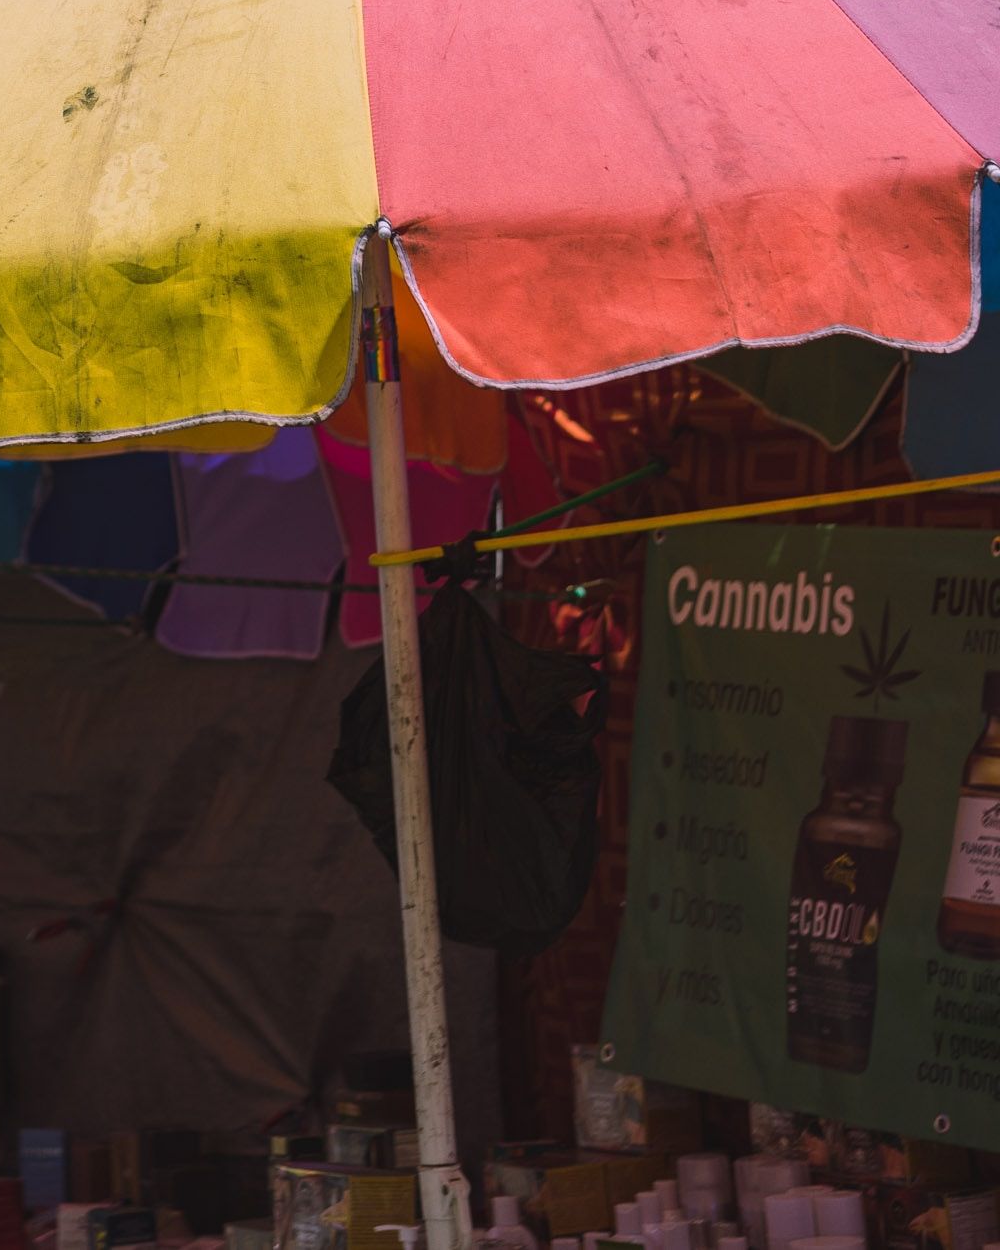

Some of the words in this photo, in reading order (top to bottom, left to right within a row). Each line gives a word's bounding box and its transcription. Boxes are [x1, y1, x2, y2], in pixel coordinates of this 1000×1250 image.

[668, 565, 855, 636] Cannabis
[926, 959, 968, 990] Para
[917, 1060, 953, 1087] con
